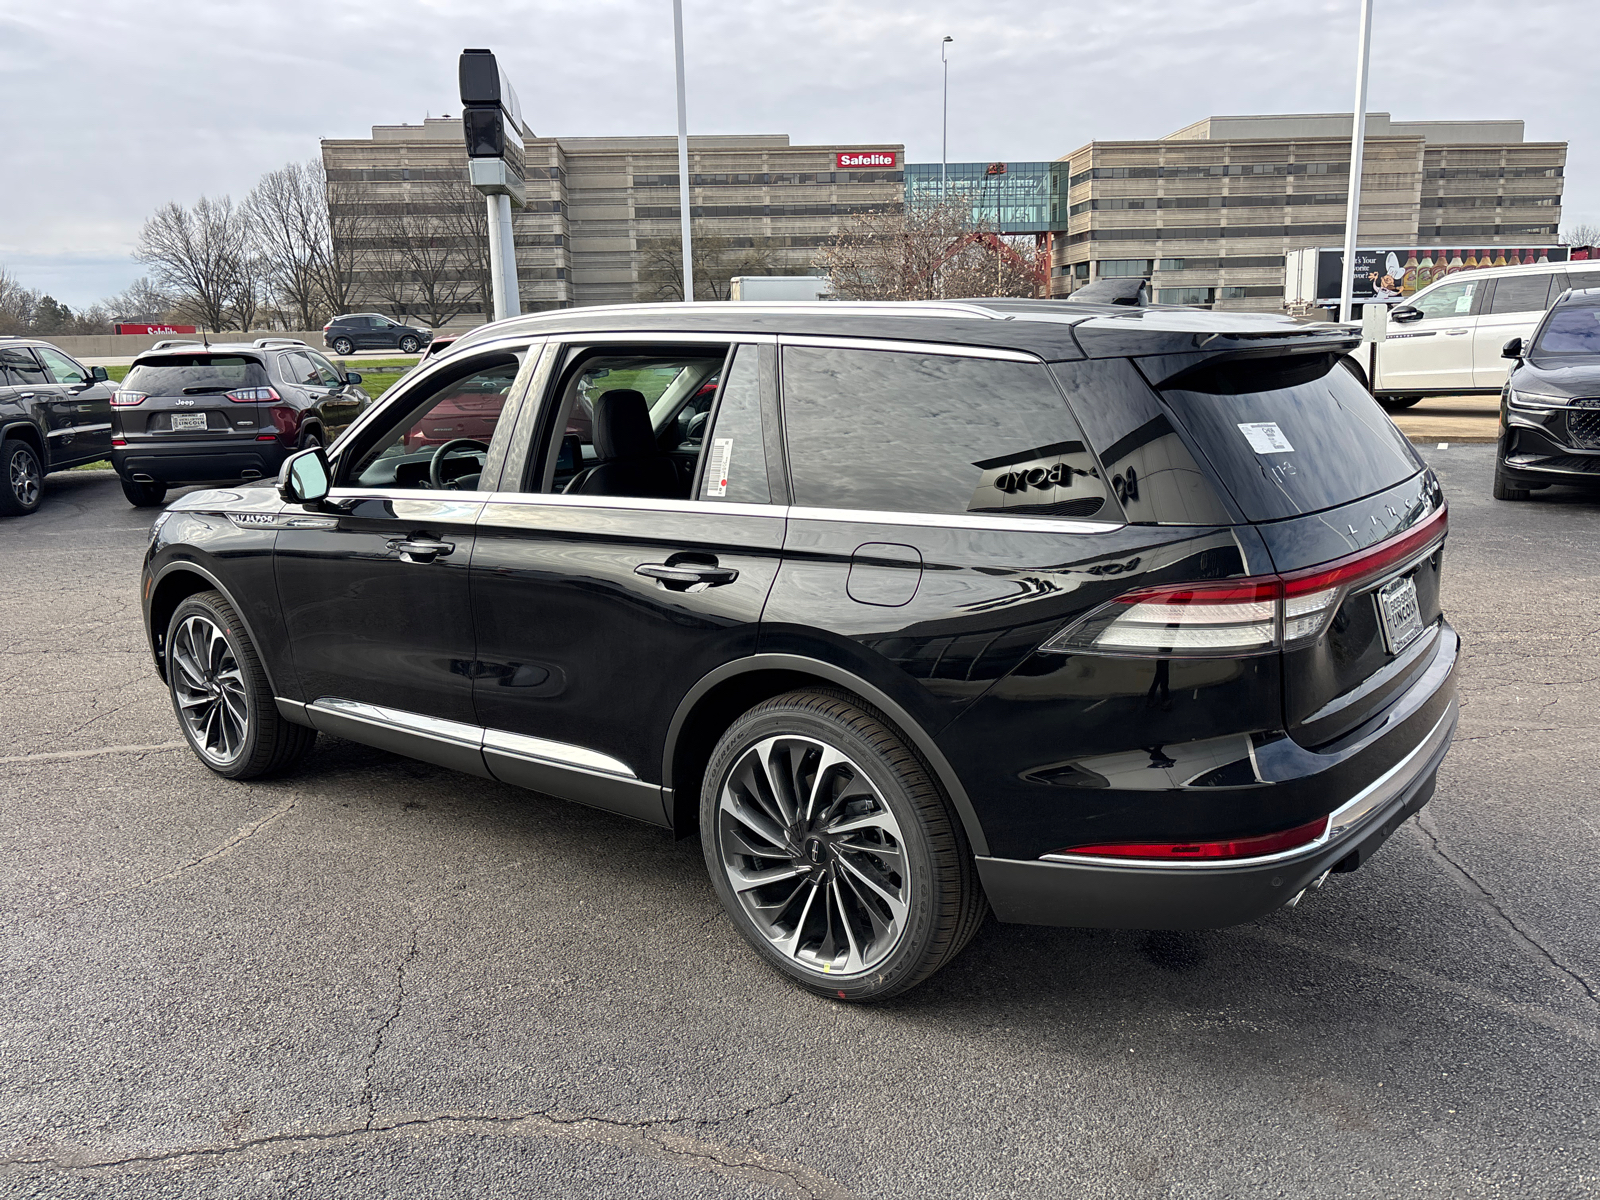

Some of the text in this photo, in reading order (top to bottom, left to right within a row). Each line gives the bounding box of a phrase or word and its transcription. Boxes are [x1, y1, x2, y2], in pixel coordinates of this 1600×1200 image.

[841, 155, 892, 165] Safelite
[1362, 256, 1376, 264] Your
[236, 514, 274, 524] AVIATOR
[1391, 598, 1416, 628] LINCOLN
[708, 731, 745, 788] TOURING
